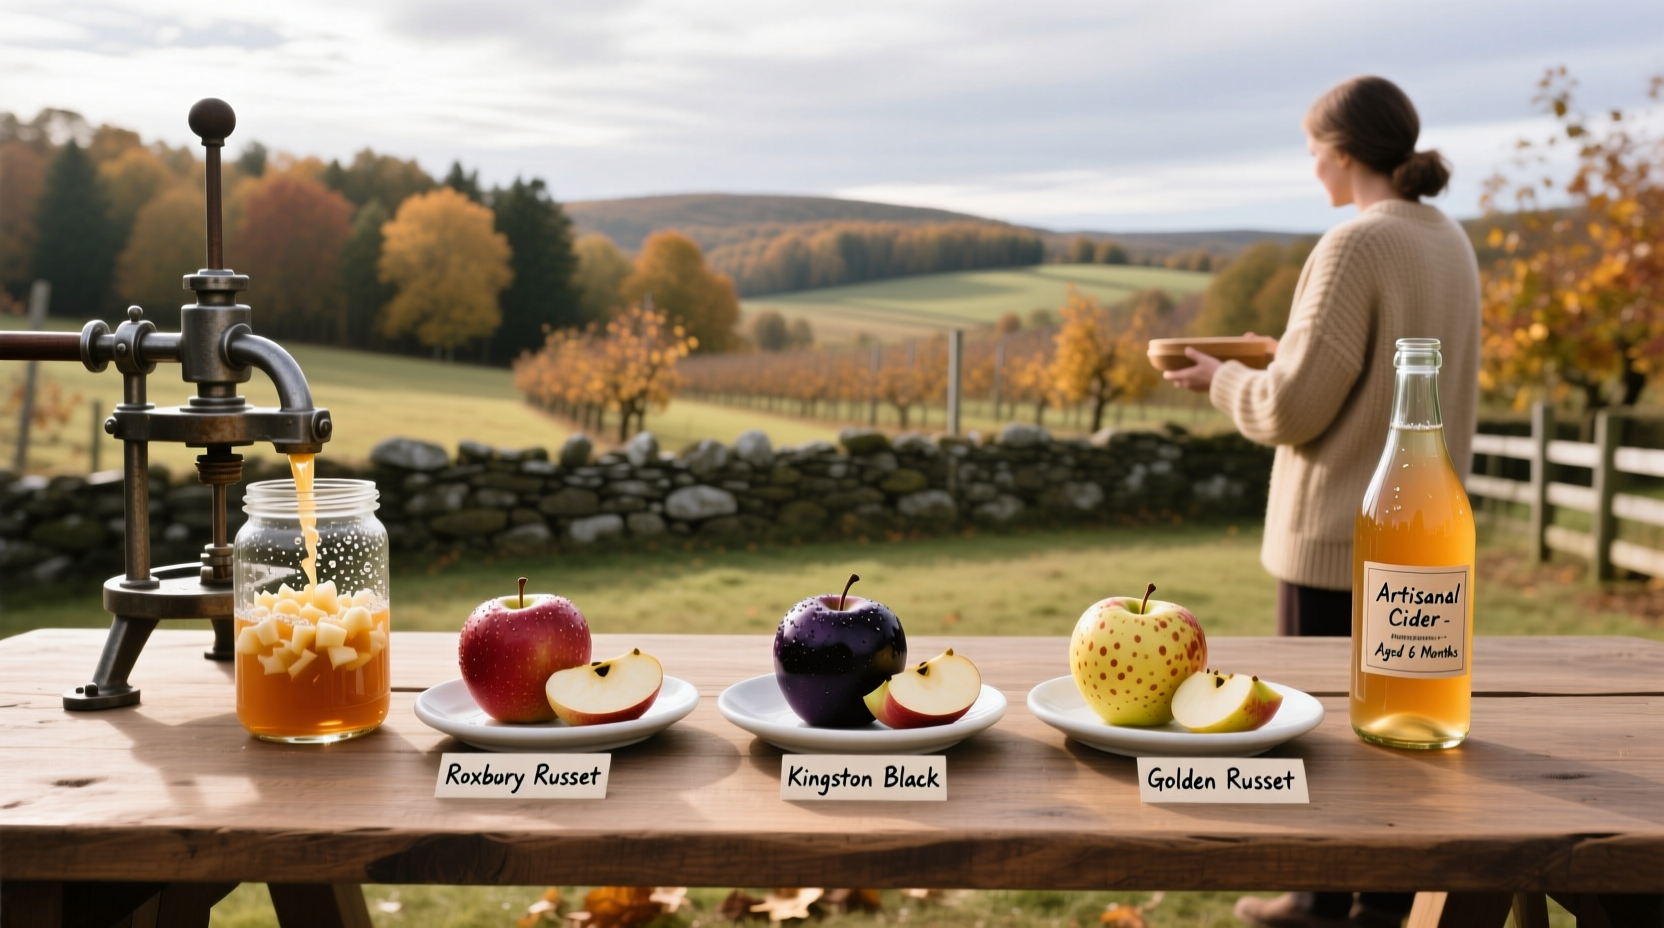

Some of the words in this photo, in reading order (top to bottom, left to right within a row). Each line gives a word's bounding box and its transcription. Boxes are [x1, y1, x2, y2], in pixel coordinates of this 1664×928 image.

[1375, 581, 1461, 605] Artisanal
[1388, 607, 1441, 627] Cider
[1374, 641, 1405, 662] Aged
[1408, 645, 1416, 659] 6
[1420, 644, 1459, 659] Months
[445, 763, 525, 794] Roxbury
[533, 763, 602, 786] Russet
[787, 765, 873, 796] Kingston
[883, 765, 940, 788] Black
[1147, 766, 1216, 792] Golden
[1227, 766, 1296, 790] Russet
